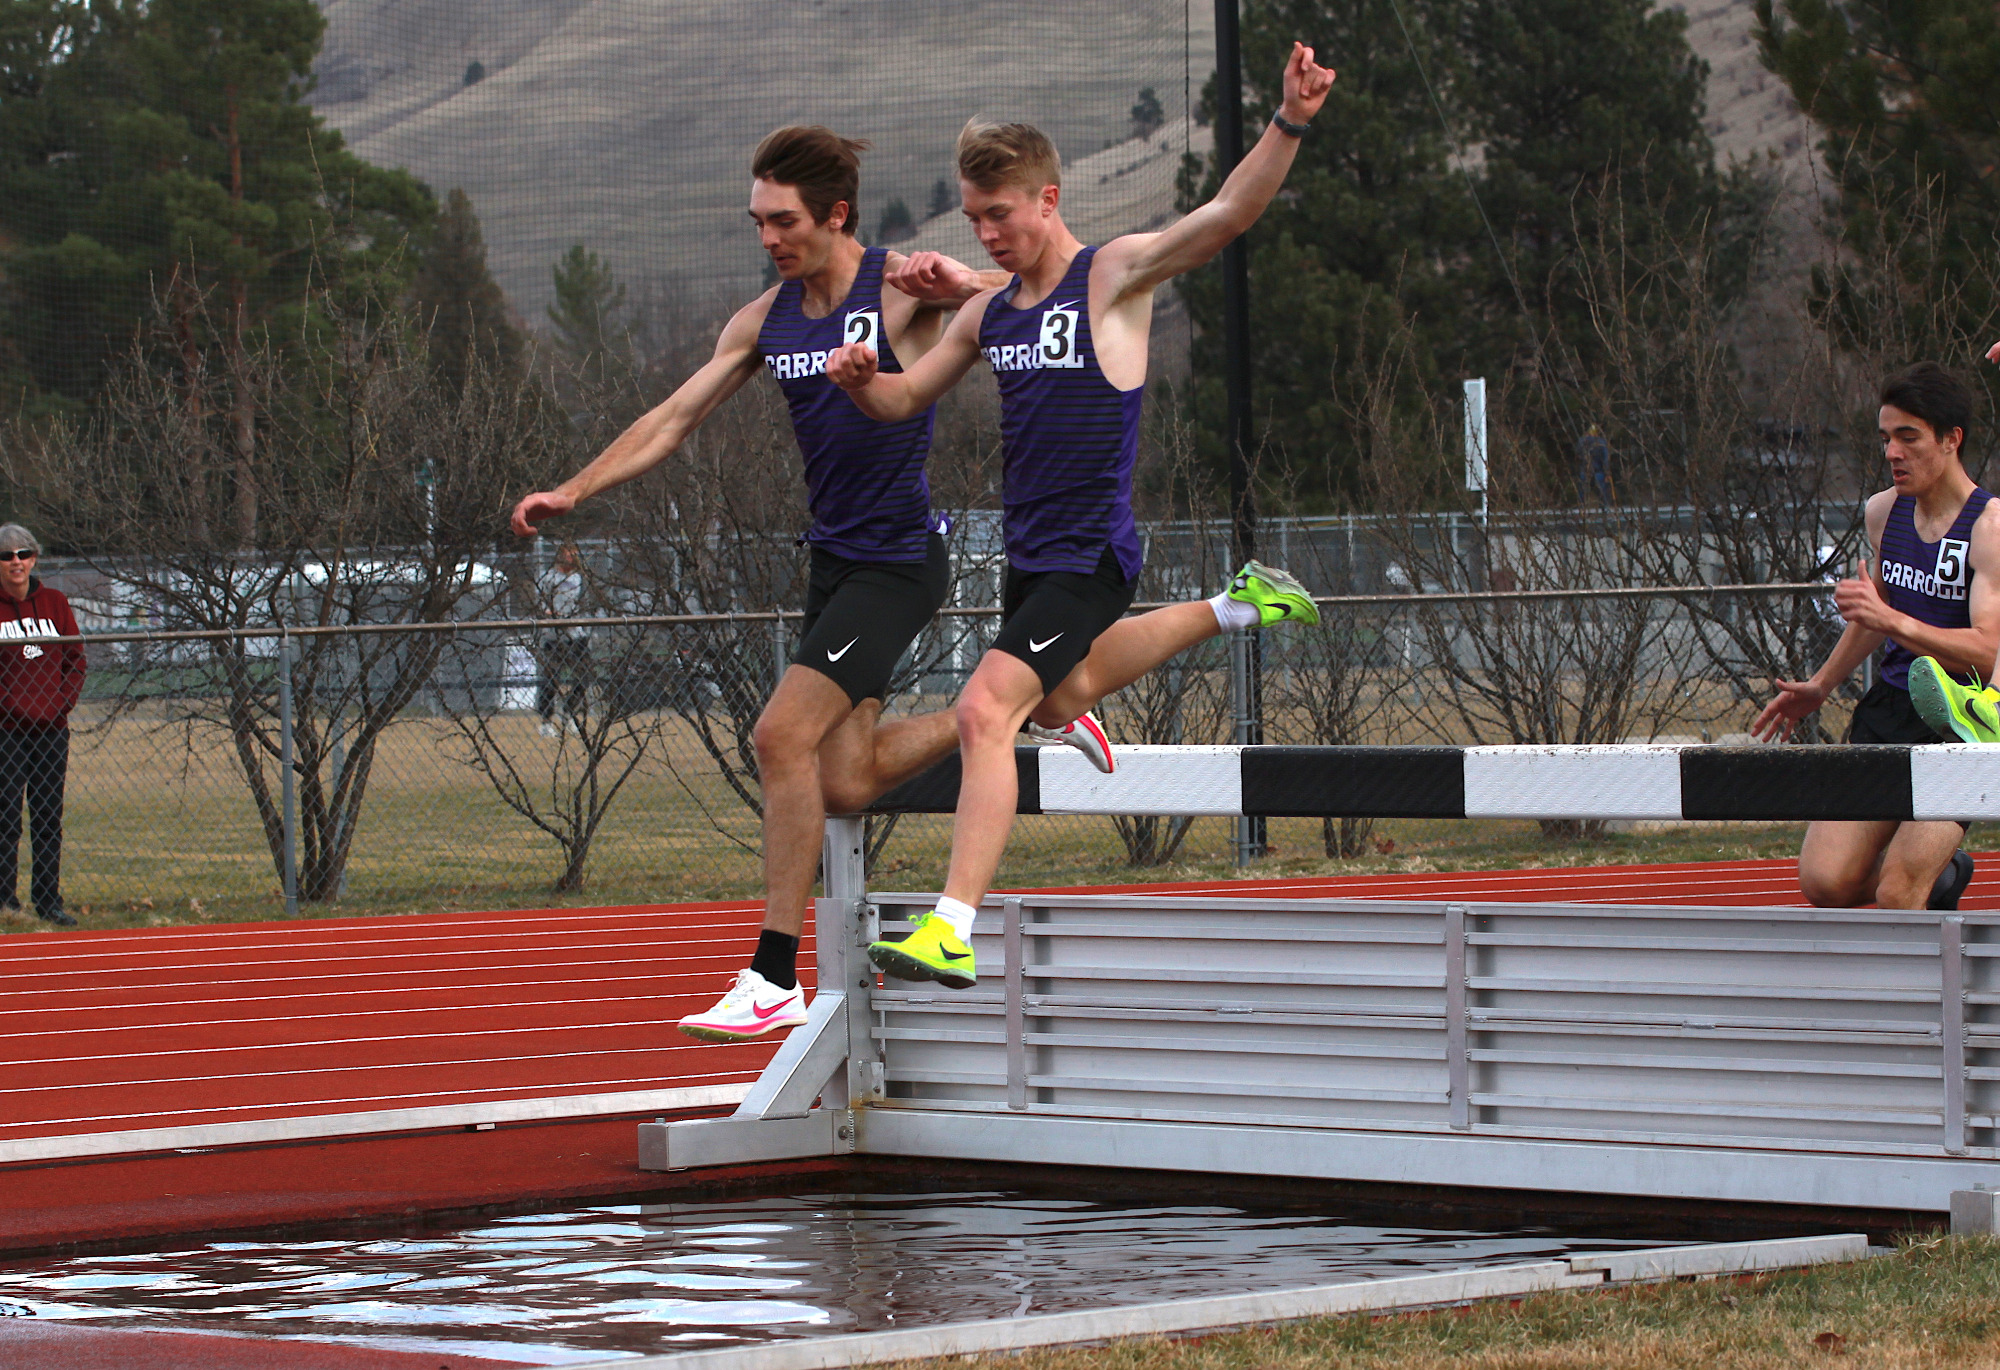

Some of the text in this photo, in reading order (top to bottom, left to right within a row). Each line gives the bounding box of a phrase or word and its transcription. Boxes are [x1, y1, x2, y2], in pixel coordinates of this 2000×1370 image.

[848, 316, 871, 344] 2
[1043, 313, 1069, 360] 3
[765, 347, 843, 379] CARR
[1938, 542, 1962, 582] 5
